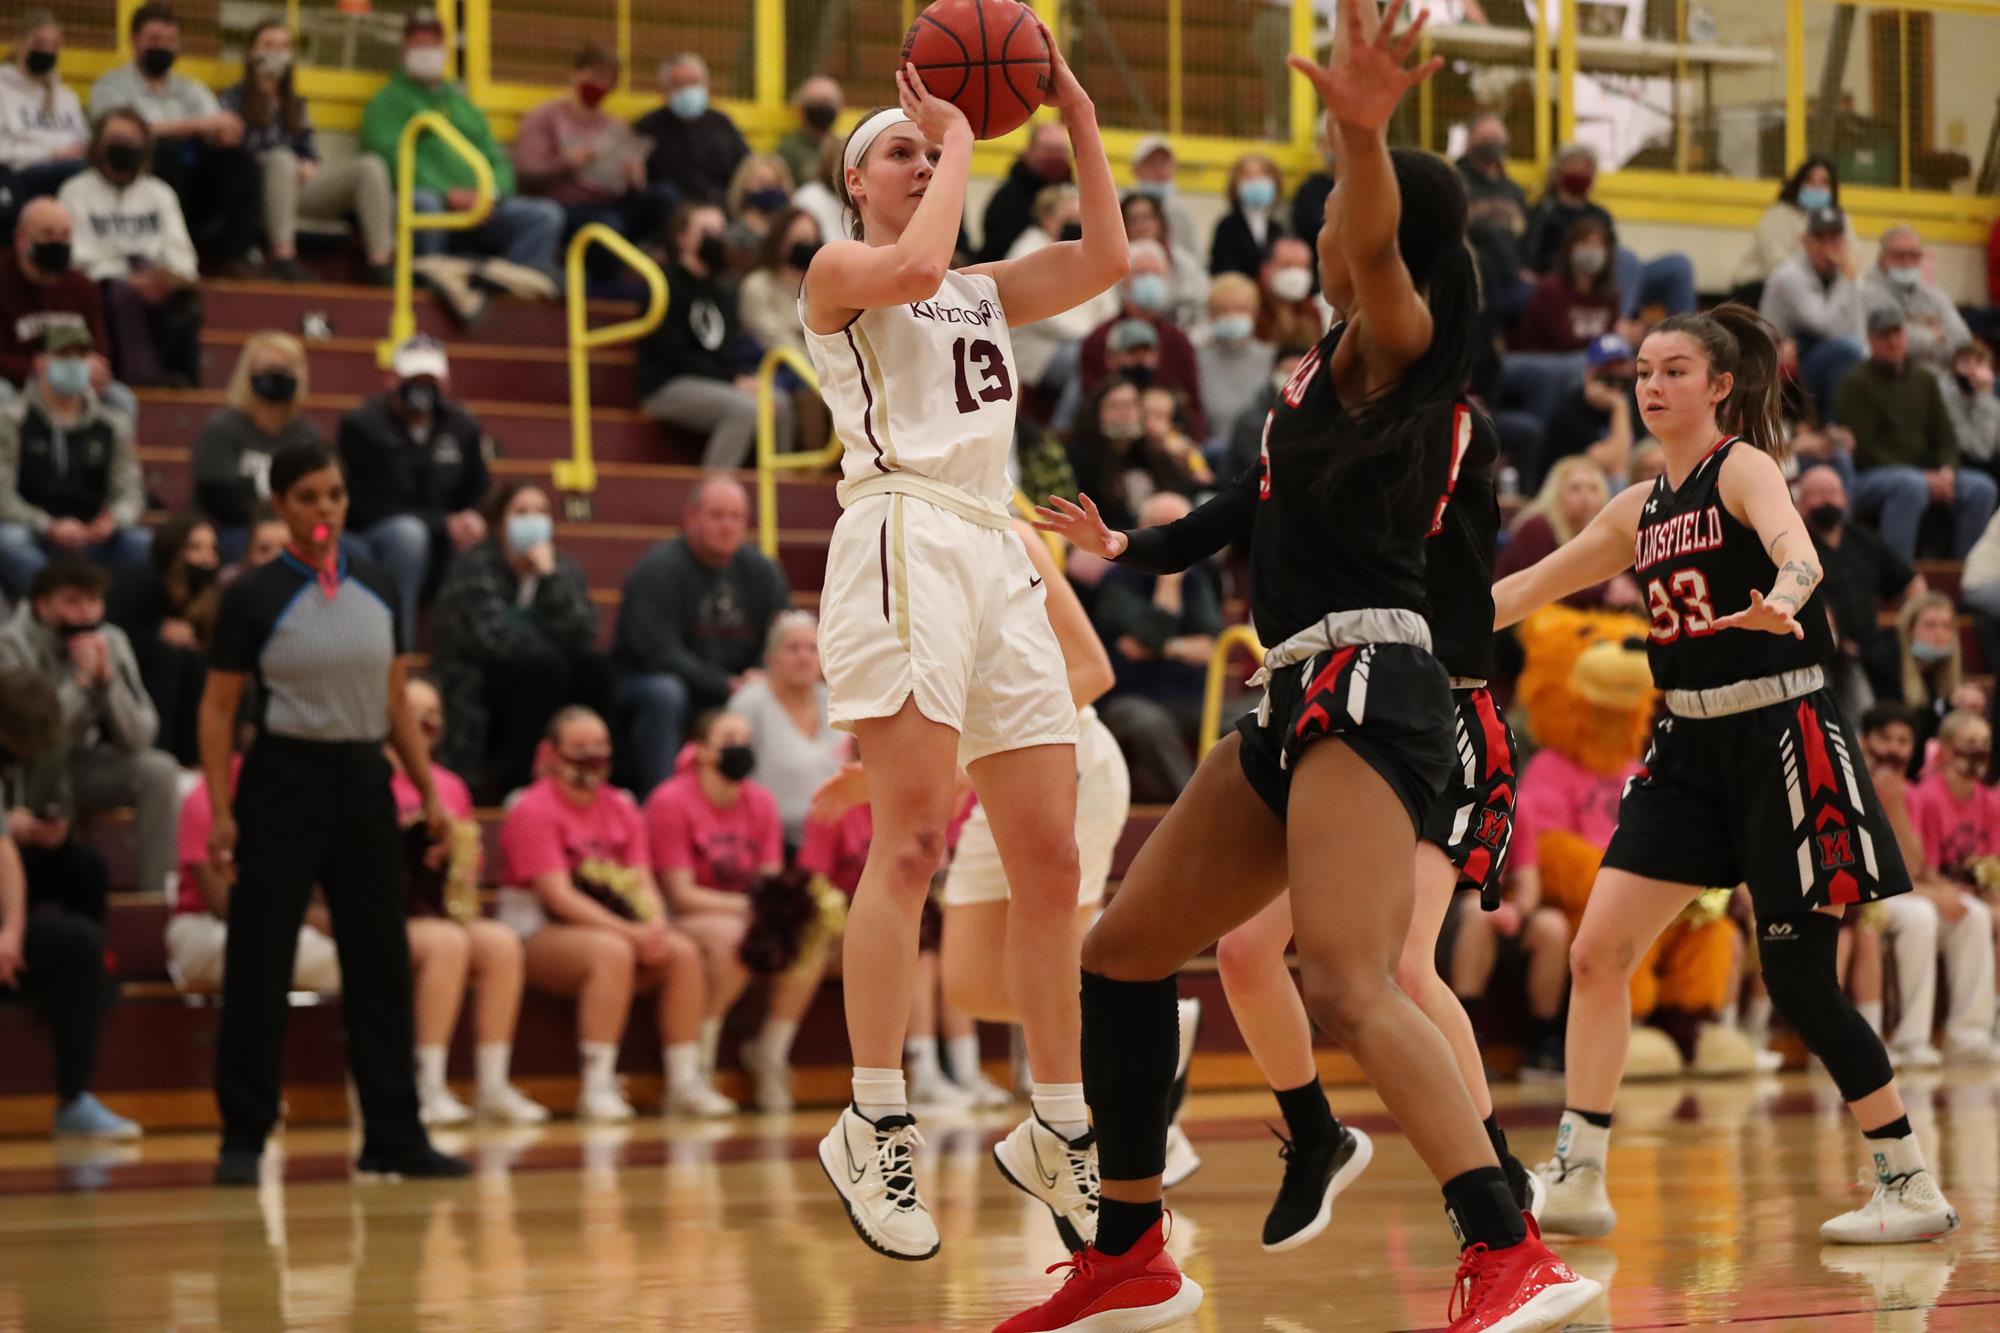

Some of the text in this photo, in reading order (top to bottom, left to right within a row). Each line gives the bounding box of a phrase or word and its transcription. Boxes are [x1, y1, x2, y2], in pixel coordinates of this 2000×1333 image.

[952, 337, 1013, 414] 13
[1474, 807, 1508, 849] M
[1816, 830, 1856, 869] M
